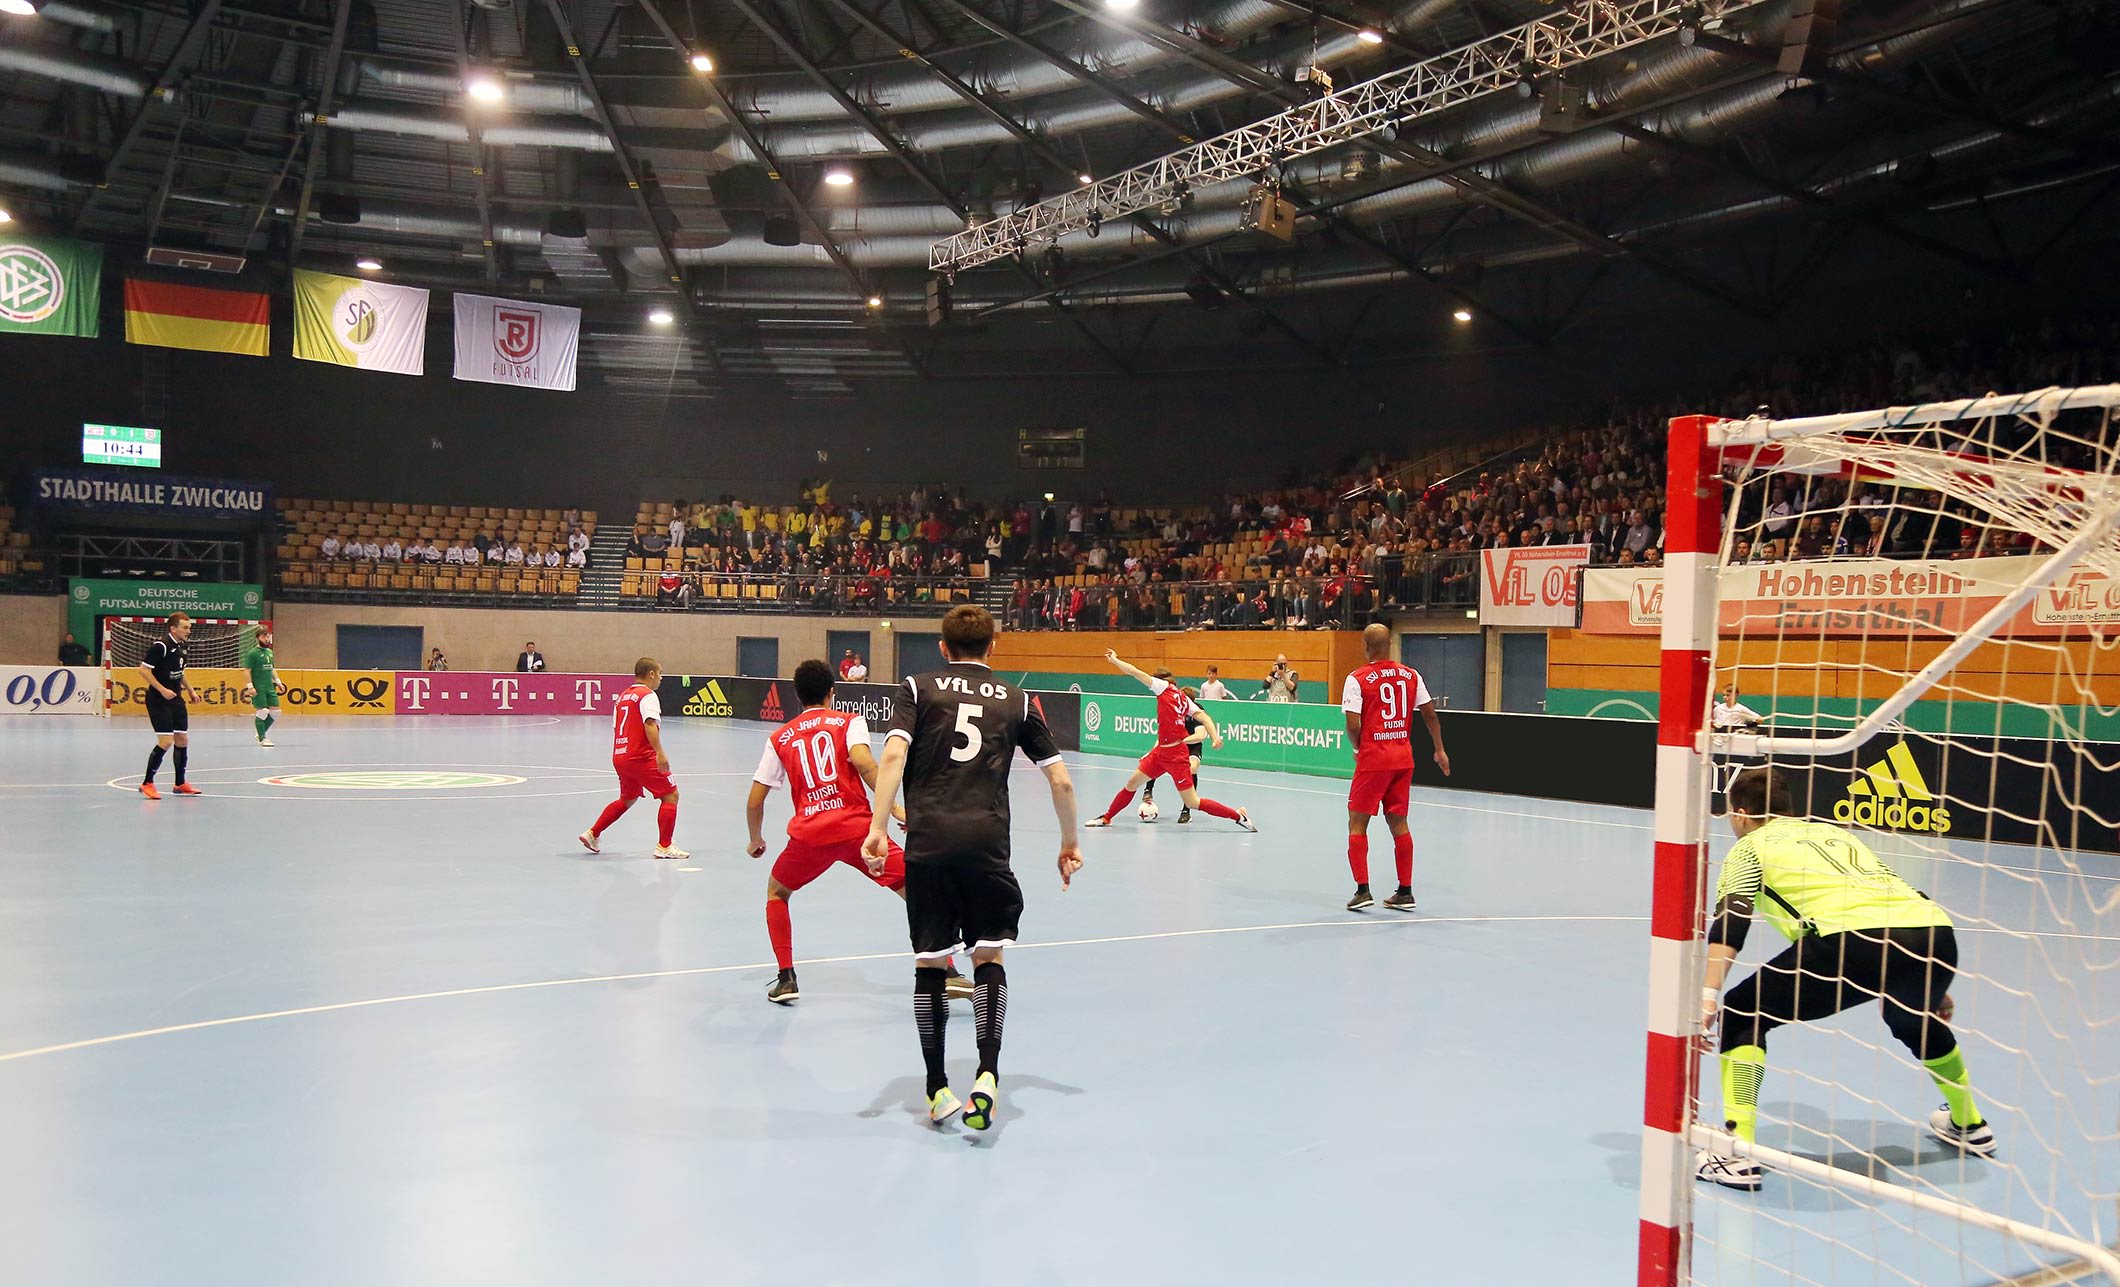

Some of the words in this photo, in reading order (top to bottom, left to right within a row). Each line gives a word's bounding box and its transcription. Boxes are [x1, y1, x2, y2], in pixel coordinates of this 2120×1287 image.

[493, 363, 537, 381] FUTSAL
[103, 442, 143, 455] 10:44
[40, 477, 165, 505] STADTHALLE
[171, 486, 263, 511] ZWICKAU
[1483, 550, 1536, 606] VfL
[1757, 566, 1976, 597] Hohenstein-
[100, 599, 235, 612] FUTSAL-MEISTERSCHAFT
[139, 588, 198, 599] DEUTSCHE
[1637, 583, 1664, 614] Vf
[1775, 600, 1944, 631] Ernstthal
[111, 681, 253, 705] Desche
[935, 676, 975, 695] VfL
[979, 682, 1008, 700] 05
[1379, 680, 1408, 720] 91
[682, 702, 733, 716] adidas
[760, 707, 784, 721] adidas
[950, 703, 984, 763] 5
[1085, 733, 1101, 741] FUTSAL
[1115, 715, 1158, 735] DEUTSC
[791, 730, 838, 789] 10
[807, 783, 839, 803] FUTSAL
[1833, 794, 1952, 833] adidas
